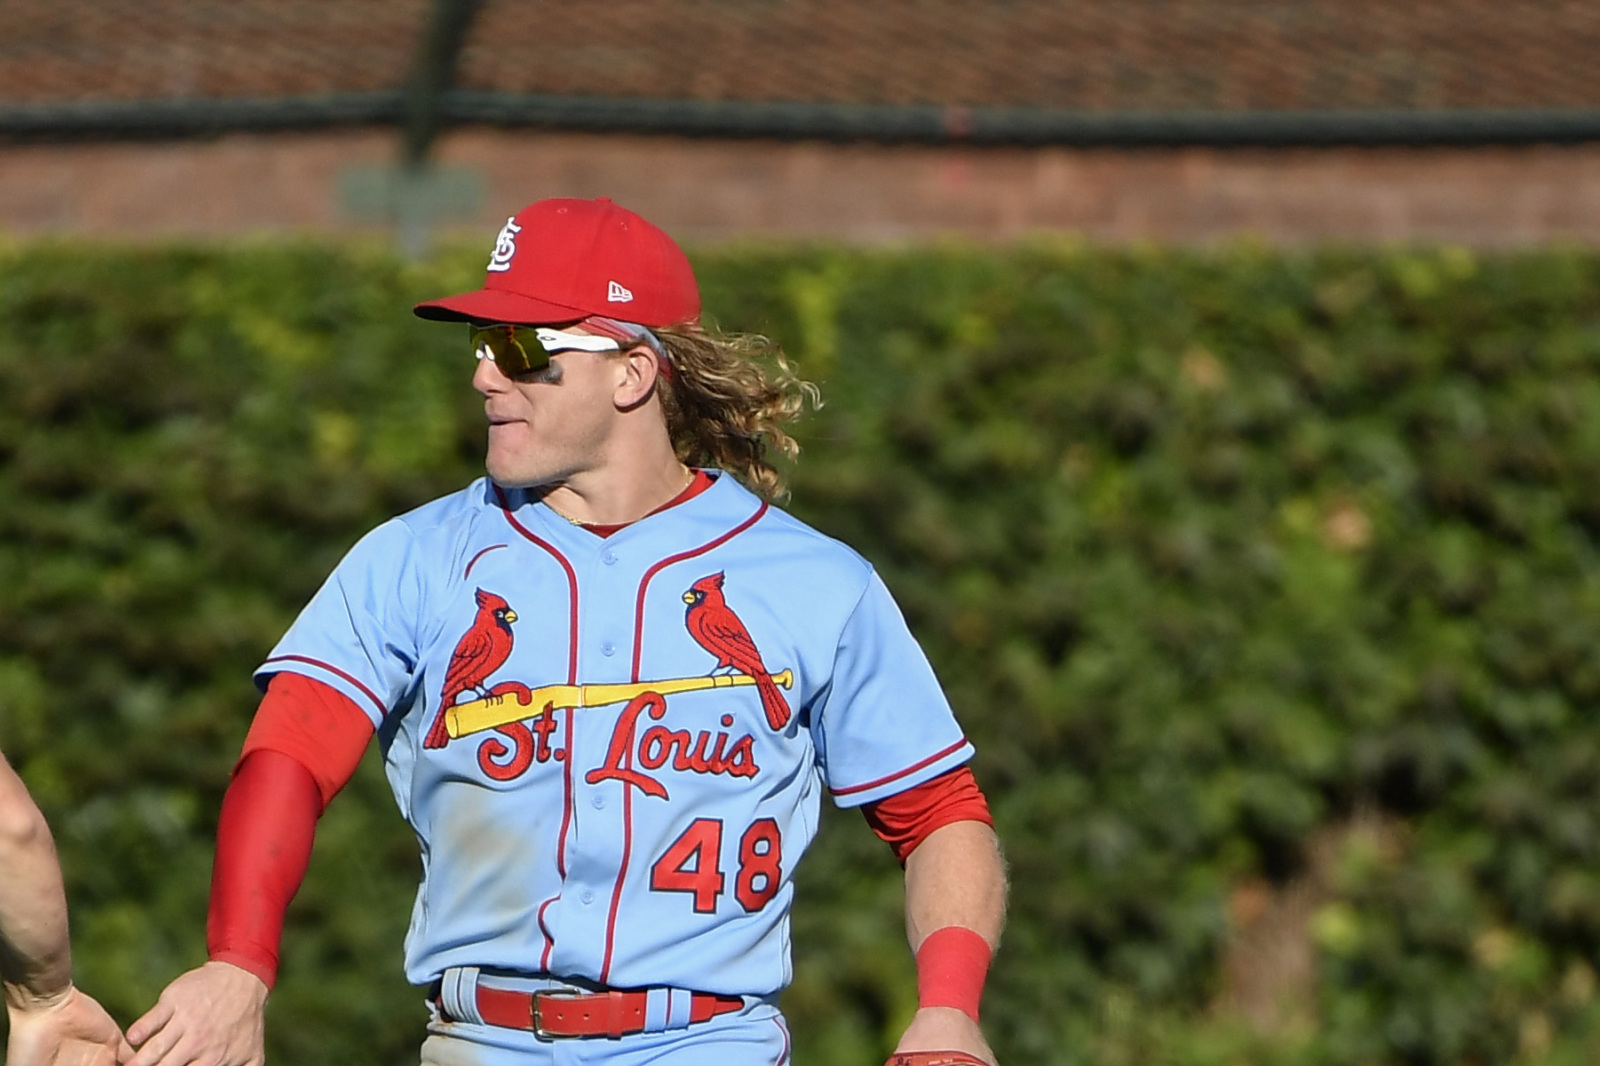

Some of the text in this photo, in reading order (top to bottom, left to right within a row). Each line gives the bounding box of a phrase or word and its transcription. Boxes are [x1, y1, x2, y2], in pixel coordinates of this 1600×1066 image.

[476, 681, 760, 801] St. Louis
[649, 817, 782, 914] 48
